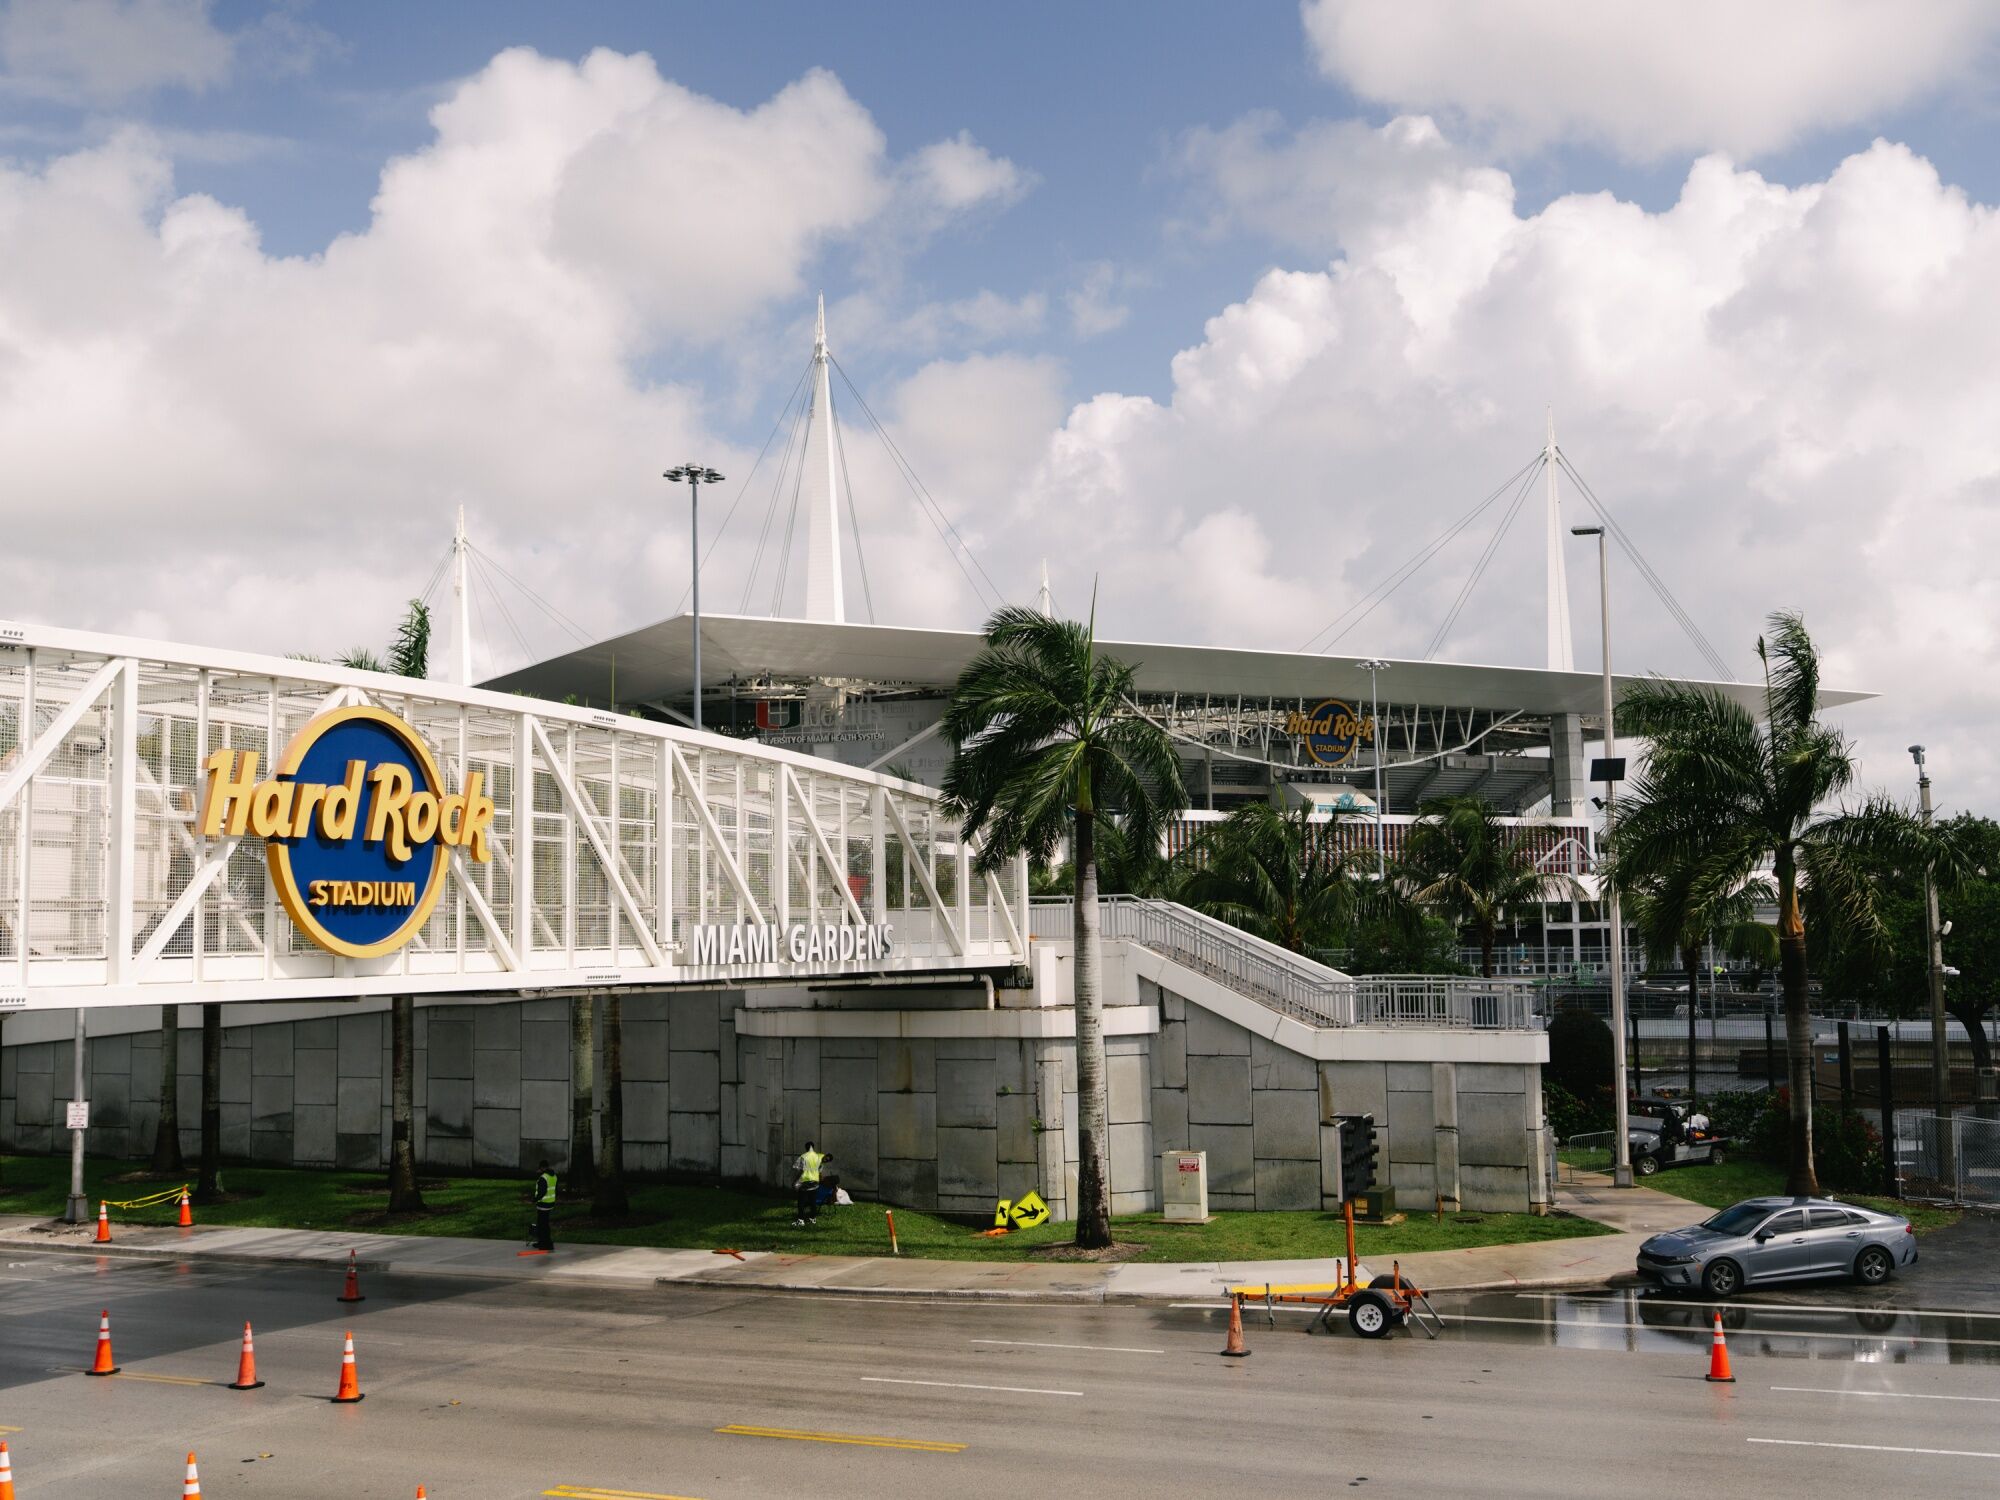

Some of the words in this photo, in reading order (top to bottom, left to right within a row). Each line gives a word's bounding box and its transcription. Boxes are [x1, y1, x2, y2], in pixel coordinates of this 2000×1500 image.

[796, 734, 805, 743] OF
[807, 734, 830, 743] MIAMI
[831, 733, 857, 742] HEALTH
[858, 732, 885, 741] SYSTEM
[1287, 711, 1334, 735] Hard
[1333, 713, 1375, 742] Rock
[1315, 744, 1346, 753] STADIUM
[198, 749, 367, 841] Hard
[366, 761, 495, 864] Rock
[310, 880, 416, 907] STADIUM
[692, 924, 779, 965] MIAMI
[787, 923, 895, 963] GARDENS
